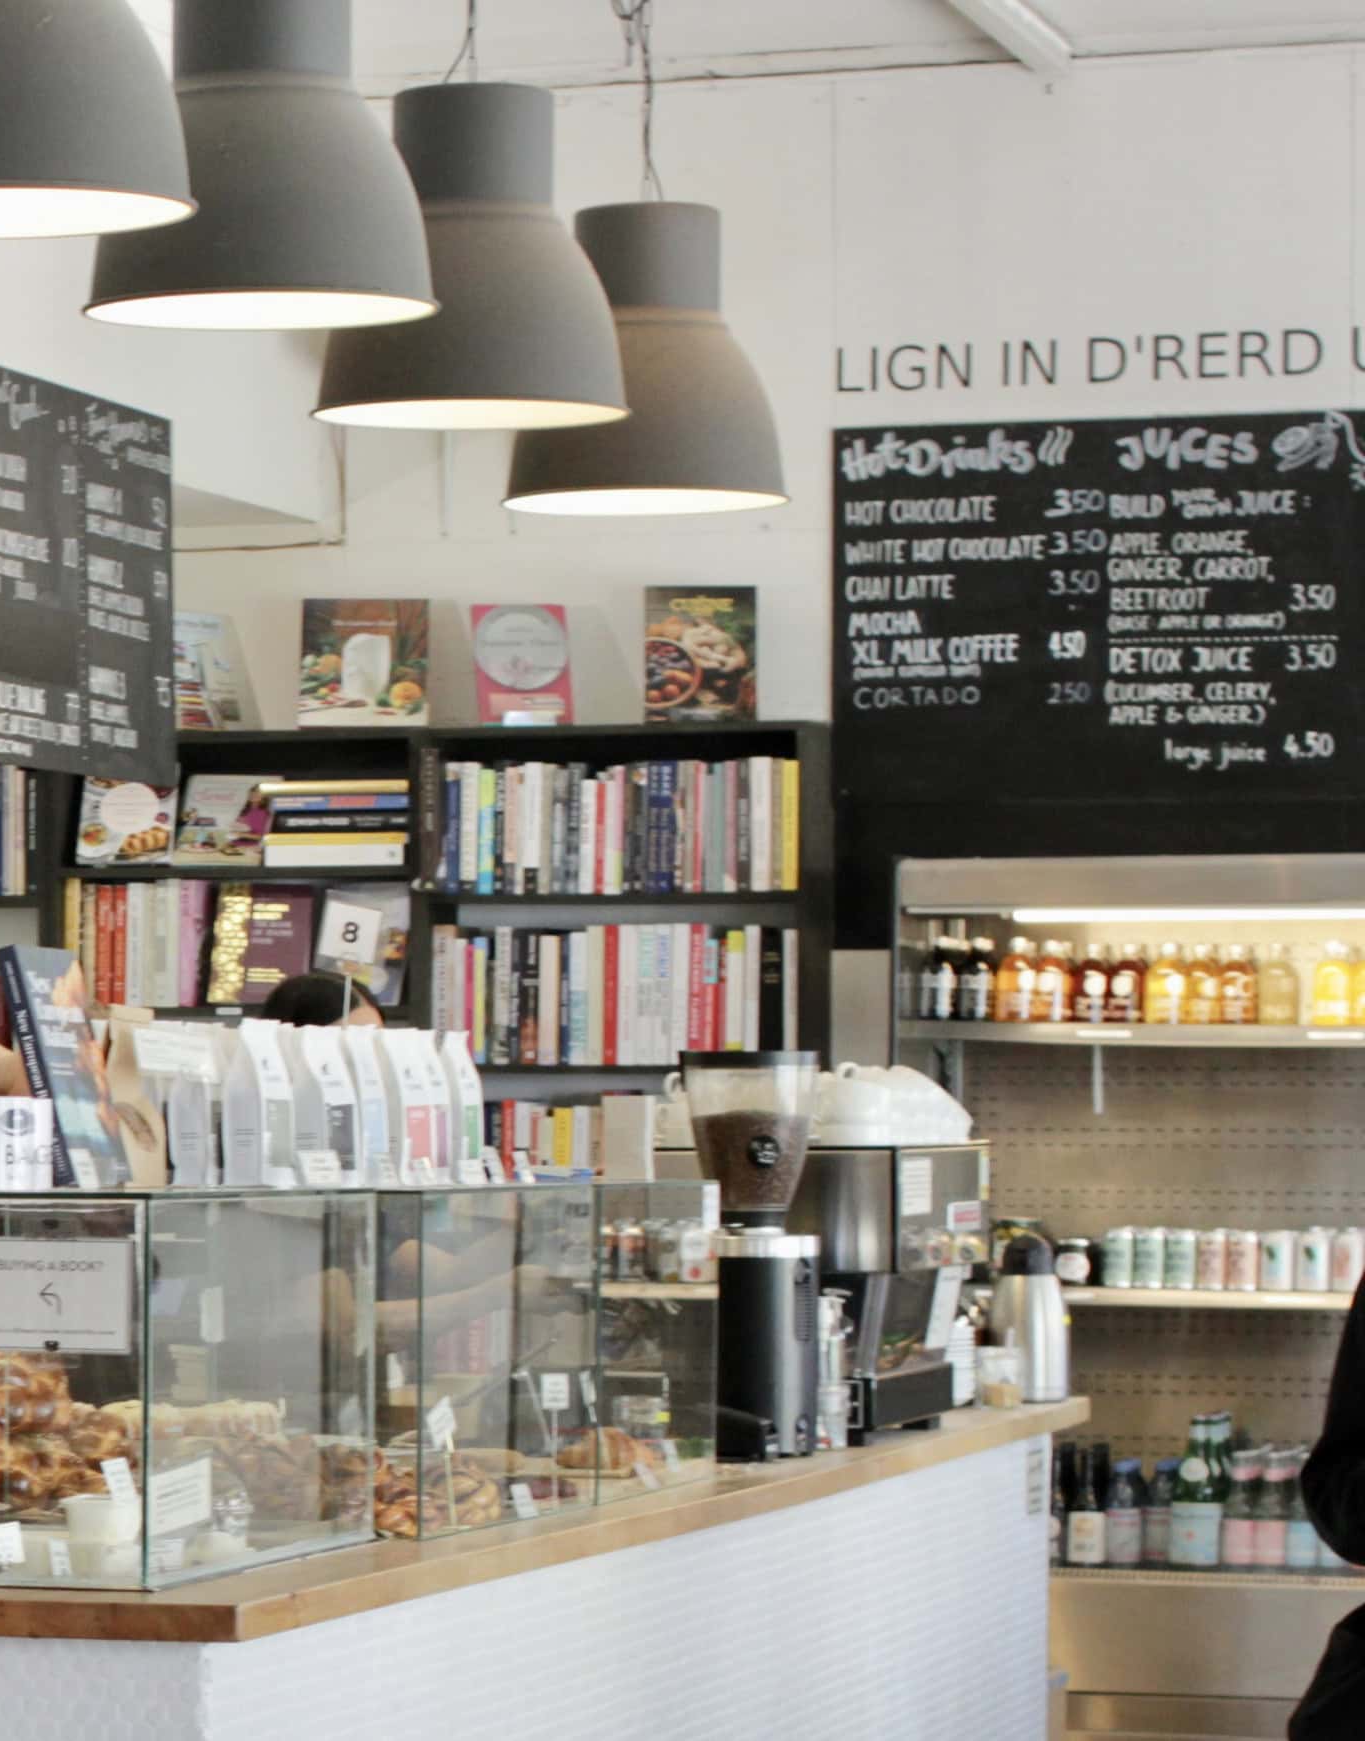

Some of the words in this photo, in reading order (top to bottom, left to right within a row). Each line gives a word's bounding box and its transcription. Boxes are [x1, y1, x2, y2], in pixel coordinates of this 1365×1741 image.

[836, 342, 973, 392] LIGN
[1002, 339, 1058, 387] IN
[1086, 328, 1324, 384] D'RERD
[841, 431, 905, 482] Hot
[905, 428, 1036, 479] Drinks
[1115, 427, 1259, 471] JUICES
[845, 500, 886, 526] HOT
[889, 496, 998, 524] CHOCOLATE
[1109, 494, 1165, 519] BUILD
[845, 539, 907, 566] WHITE
[912, 538, 947, 563] HOT
[949, 535, 1048, 561] CHOCOLATE
[845, 576, 891, 602] CHAI
[895, 574, 956, 600] LATTE
[1109, 587, 1210, 612] BEETROOT
[848, 610, 923, 638] MOCHA
[853, 640, 886, 667] XL
[892, 638, 943, 665] MILK
[948, 633, 1020, 663] COFFEE
[1109, 647, 1183, 674] DETOX
[1191, 646, 1254, 673] JUICE
[853, 686, 982, 711] CORTADO
[1108, 704, 1160, 725] APPLE
[1164, 738, 1213, 771] large
[1216, 742, 1268, 771] juice
[341, 921, 357, 944] 8
[47, 1260, 57, 1271] A
[59, 1259, 105, 1272] BOOK?
